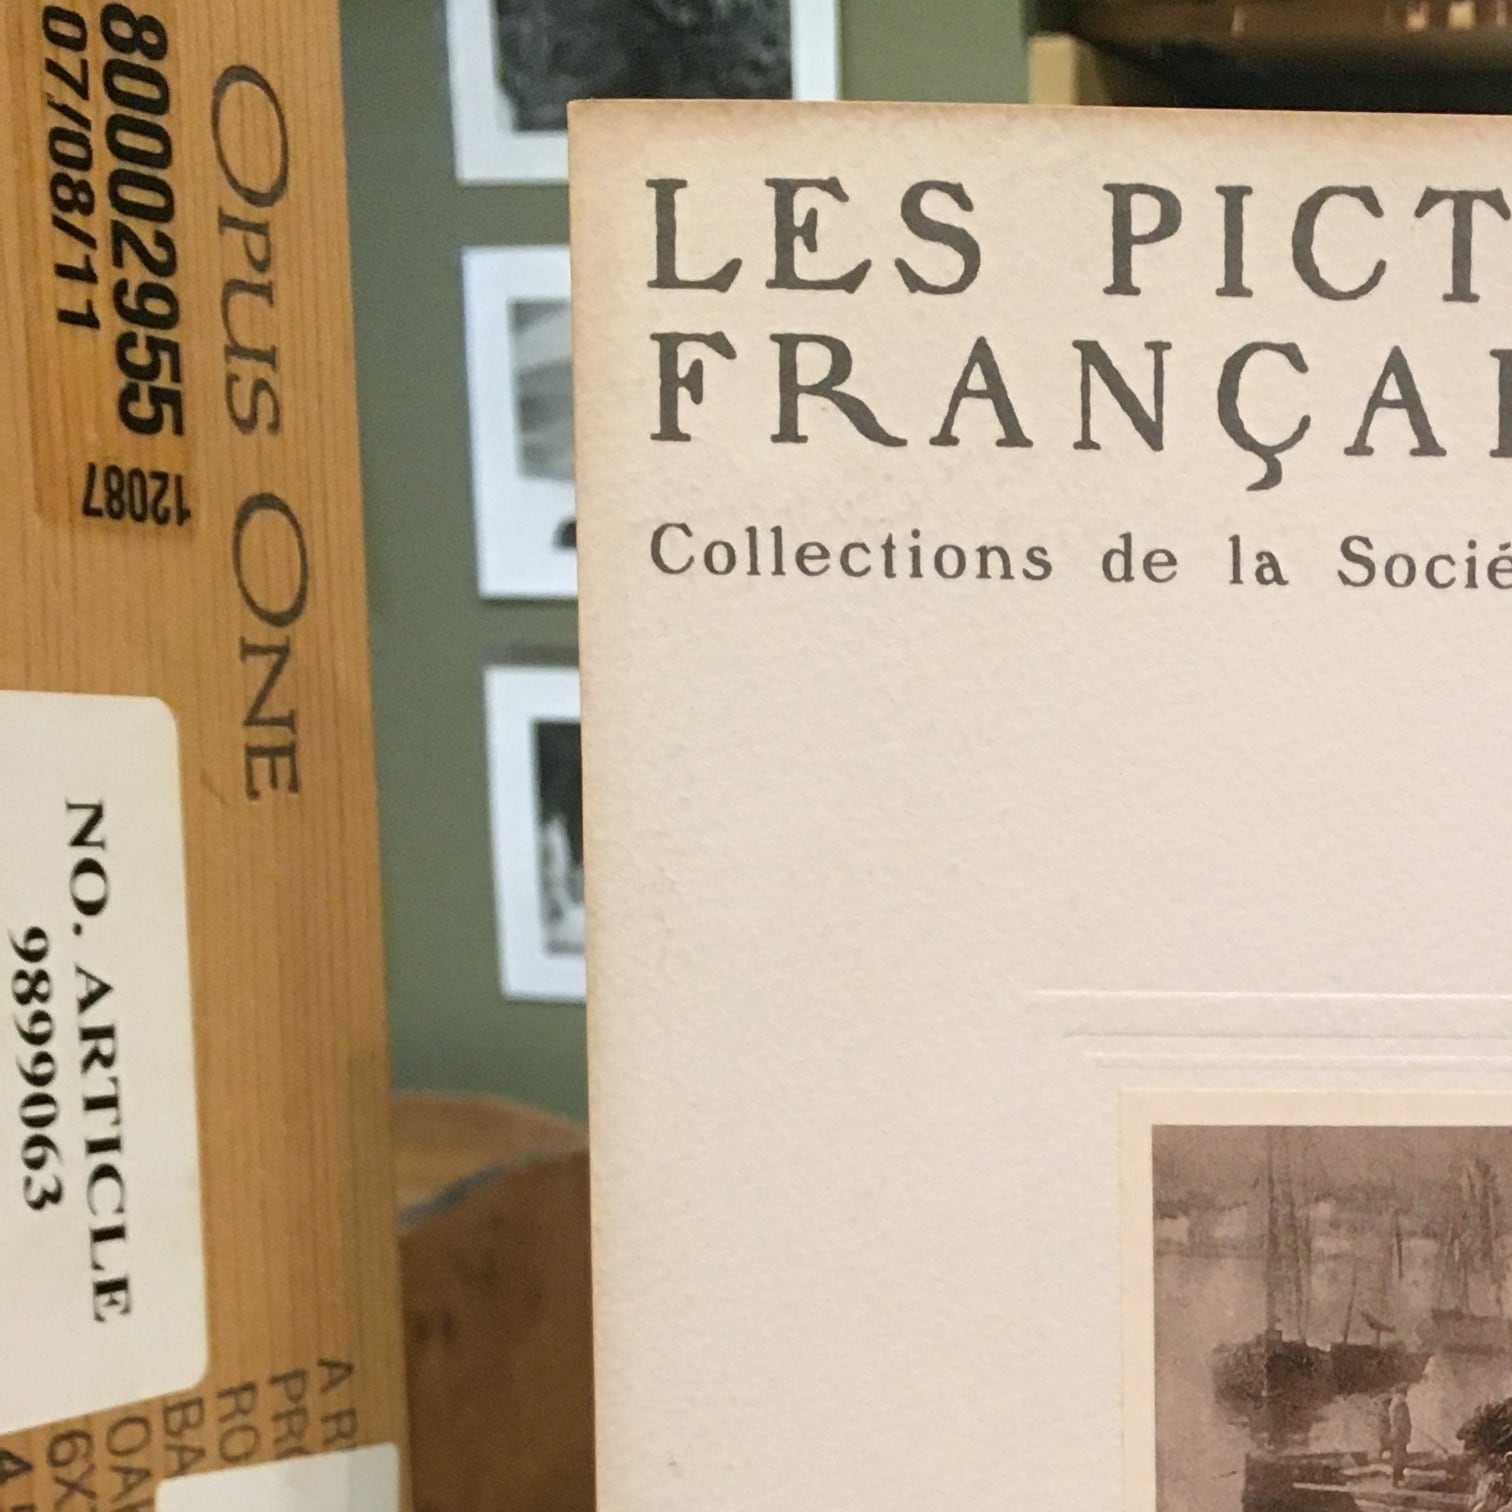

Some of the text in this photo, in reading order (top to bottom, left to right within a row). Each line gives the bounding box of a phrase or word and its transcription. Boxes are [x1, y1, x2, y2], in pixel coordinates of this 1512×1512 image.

[42, 6, 102, 329] 07/08/11
[100, 3, 184, 436] 80002955
[646, 177, 980, 295] LES
[83, 463, 190, 525] 12087
[651, 523, 1052, 581] Collections
[1102, 532, 1177, 583] de
[1230, 535, 1288, 586] la
[10, 927, 63, 1211] 9899063
[66, 802, 131, 1322] NO. ARTICLE
[322, 1408, 359, 1449] R
